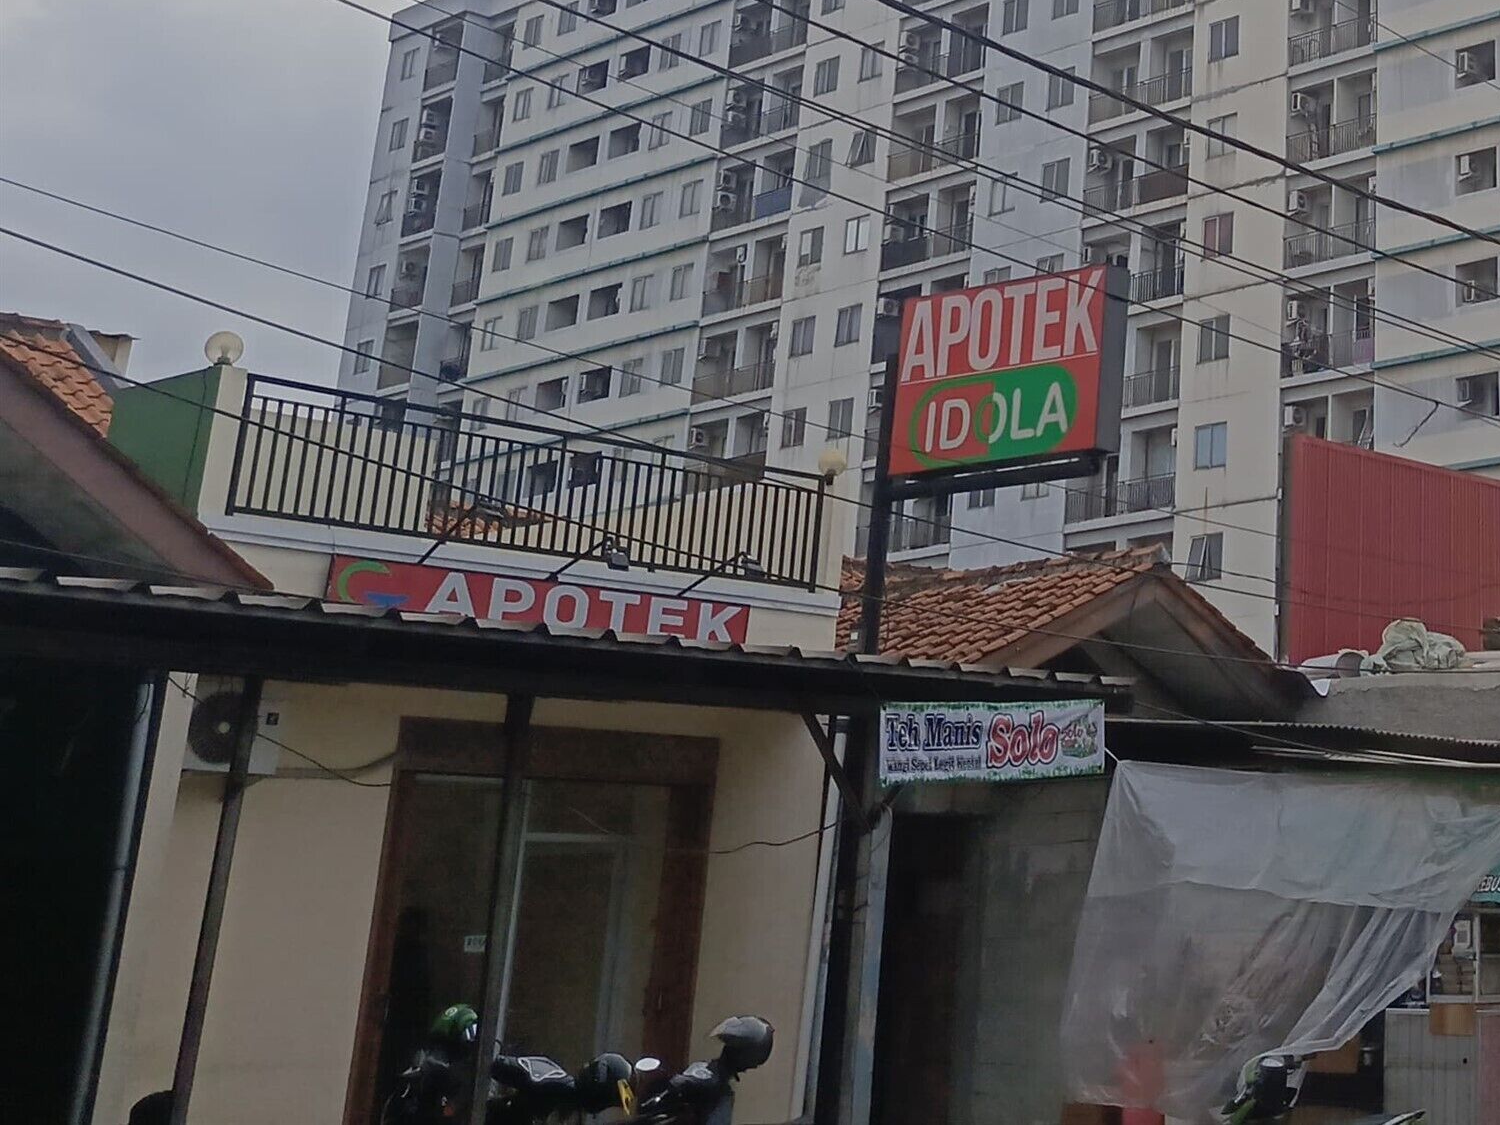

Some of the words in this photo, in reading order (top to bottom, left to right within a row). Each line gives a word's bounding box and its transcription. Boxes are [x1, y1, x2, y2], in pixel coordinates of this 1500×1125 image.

[901, 269, 1103, 382] APOTEK
[925, 382, 1068, 453] IDOLA
[424, 571, 742, 643] APOTEK
[885, 713, 919, 751] Teh
[923, 713, 984, 752] Manis
[986, 709, 1060, 770] Solo
